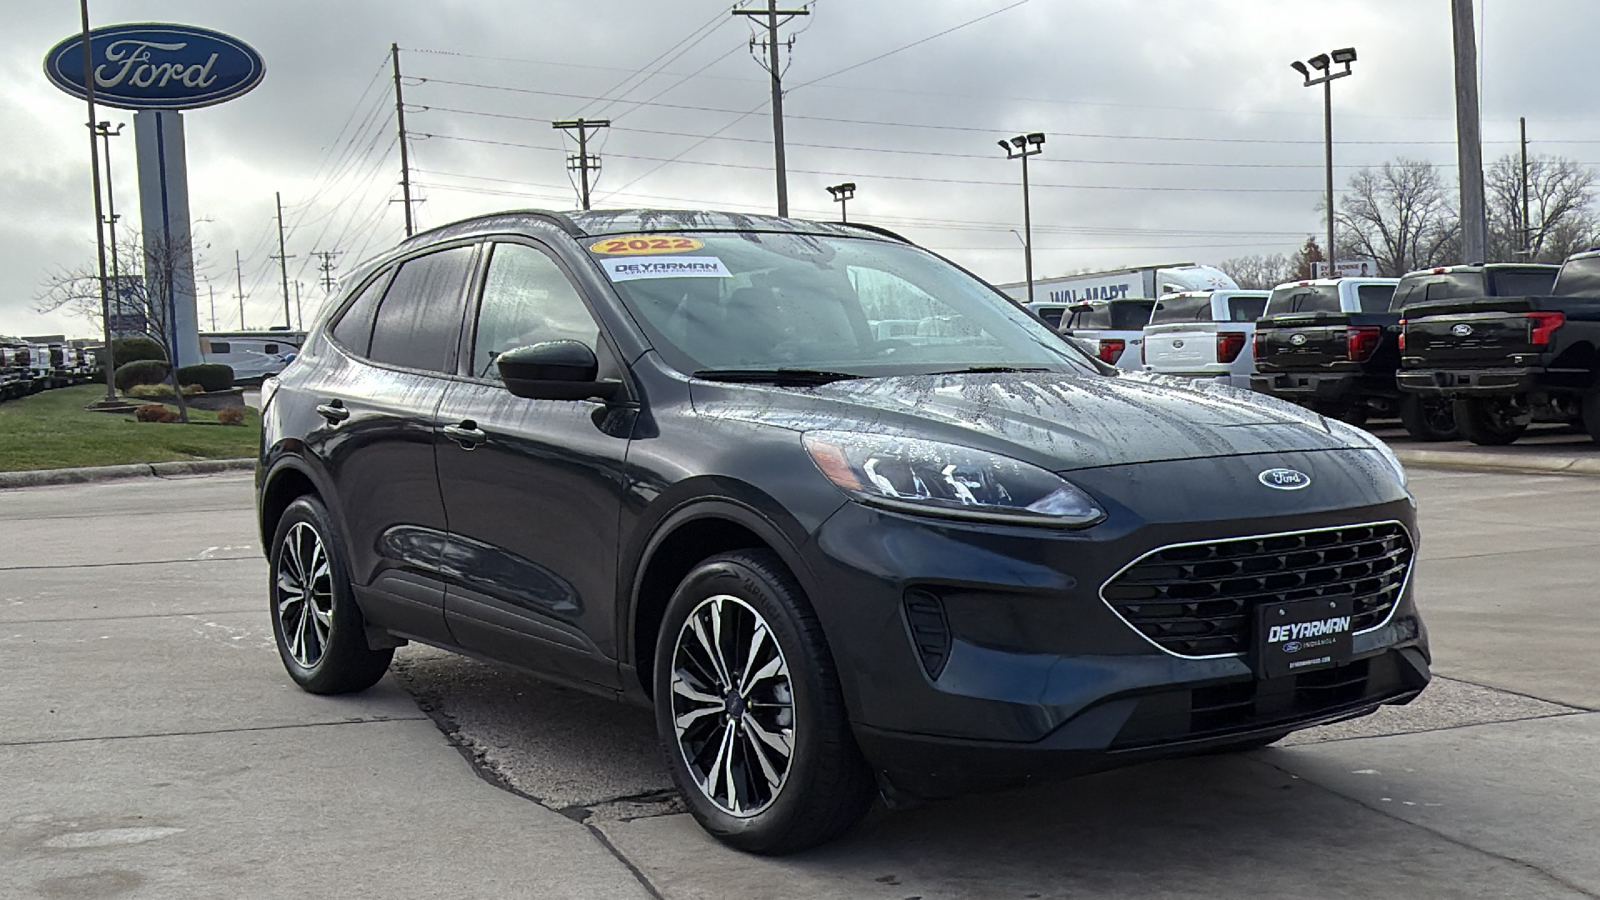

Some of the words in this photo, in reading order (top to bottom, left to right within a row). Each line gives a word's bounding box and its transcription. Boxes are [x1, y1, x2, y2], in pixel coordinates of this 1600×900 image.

[94, 39, 219, 88] Ford
[606, 238, 694, 252] 2022
[615, 262, 718, 273] DEYARMAN
[1267, 616, 1351, 643] DEYARMAN
